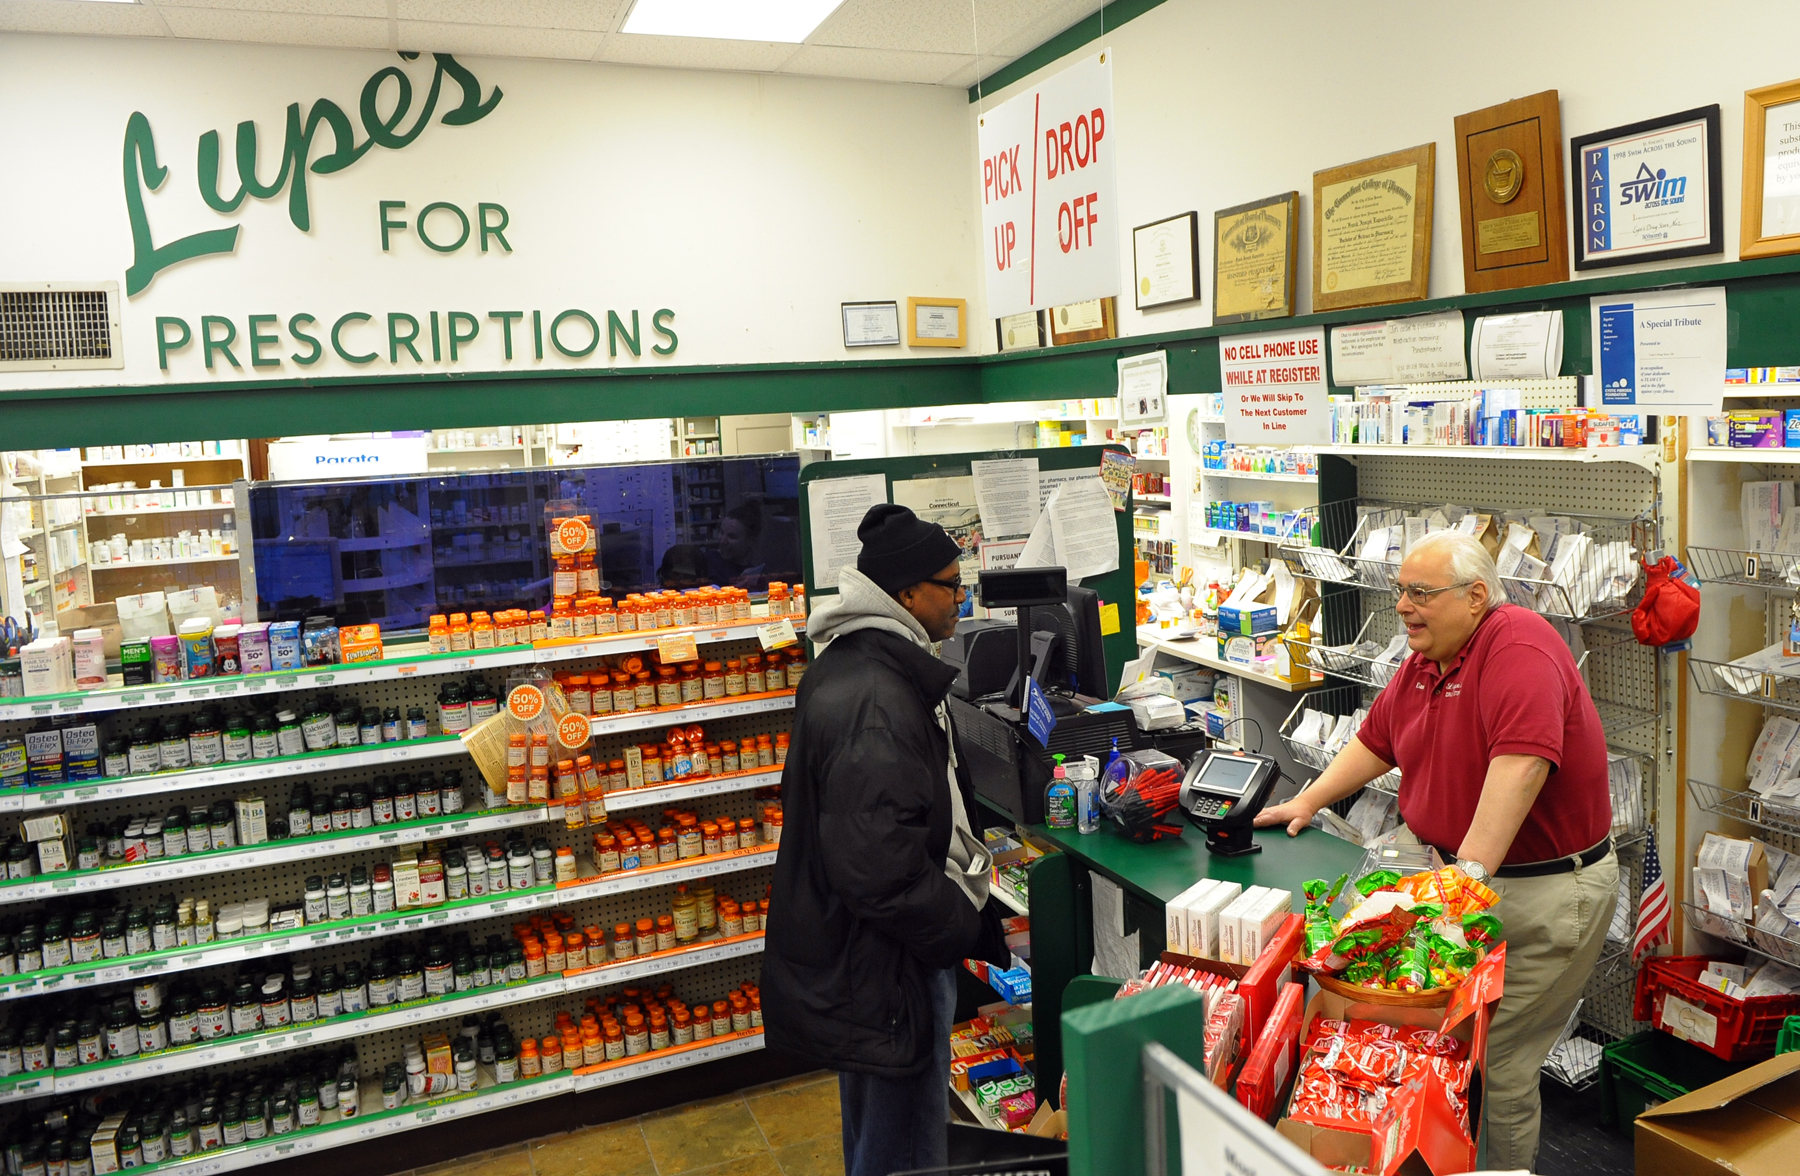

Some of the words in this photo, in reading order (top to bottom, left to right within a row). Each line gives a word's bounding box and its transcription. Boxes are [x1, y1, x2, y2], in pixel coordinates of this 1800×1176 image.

[1046, 107, 1105, 180] DROP
[1613, 151, 1626, 160] 1998
[123, 51, 504, 298] Lupe's
[983, 144, 1023, 205] PICK
[1620, 168, 1687, 206] swim
[1591, 151, 1606, 249] PATRON
[379, 200, 514, 253] FOR
[1058, 192, 1098, 254] OFF
[994, 221, 1016, 271] UP
[1639, 320, 1645, 329] A
[1646, 319, 1672, 330] Special
[1674, 318, 1702, 327] Tribute
[155, 308, 680, 371] PRESCRIPTIONS
[1224, 347, 1237, 361] NO
[1239, 344, 1261, 360] CELL
[1263, 341, 1296, 358] PHONE
[1298, 339, 1318, 356] USE
[1226, 370, 1254, 385] WHILE
[1256, 369, 1267, 384] AT
[1269, 366, 1320, 383] REGISTER!
[1240, 394, 1249, 403] Or
[1250, 394, 1261, 402] We
[1262, 394, 1275, 402] Will
[1277, 393, 1293, 403] Skip
[1294, 393, 1304, 401] To
[1254, 408, 1271, 416] Next
[1272, 408, 1307, 416] Customer
[1262, 422, 1270, 430] In
[1271, 422, 1287, 430] Line
[315, 453, 380, 465] Parata
[929, 501, 960, 509] Connecticut
[562, 527, 584, 537] 50%
[123, 646, 147, 655] MEN'S
[247, 651, 263, 660] 50+
[277, 648, 293, 656] 50+
[513, 693, 539, 705] 50%
[517, 704, 535, 713] OFF
[562, 721, 586, 734] 50%
[28, 734, 59, 744] Osteo
[65, 729, 95, 739] Osteo
[566, 731, 583, 741] OFF
[505, 979, 528, 988] Herbs
